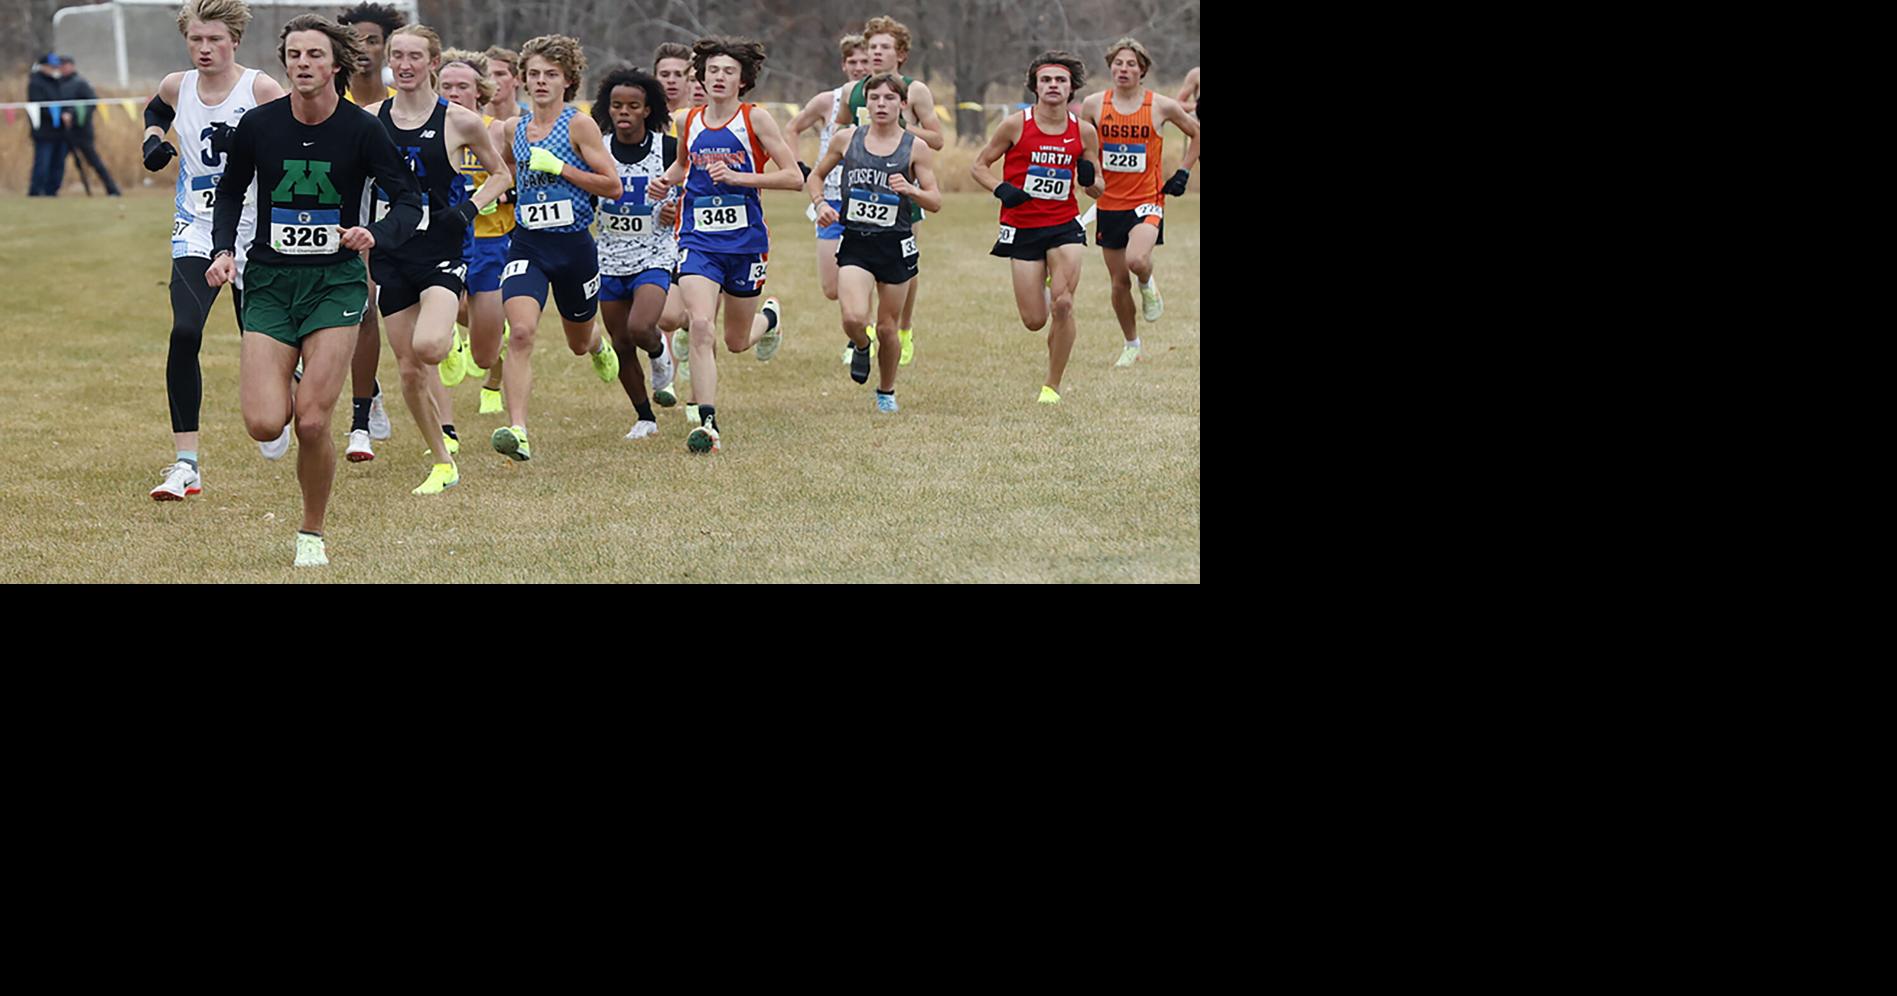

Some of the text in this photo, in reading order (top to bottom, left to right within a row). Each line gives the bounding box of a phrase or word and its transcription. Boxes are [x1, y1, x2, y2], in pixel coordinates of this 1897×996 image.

[1102, 124, 1150, 138] OSSEO
[1031, 151, 1073, 165] NORTH
[1109, 154, 1138, 167] 228
[271, 160, 342, 204] M
[1032, 178, 1064, 195] 250
[528, 203, 560, 222] 211
[702, 208, 738, 225] 348
[856, 202, 889, 220] 332
[609, 216, 643, 232] 230
[282, 226, 328, 247] 326
